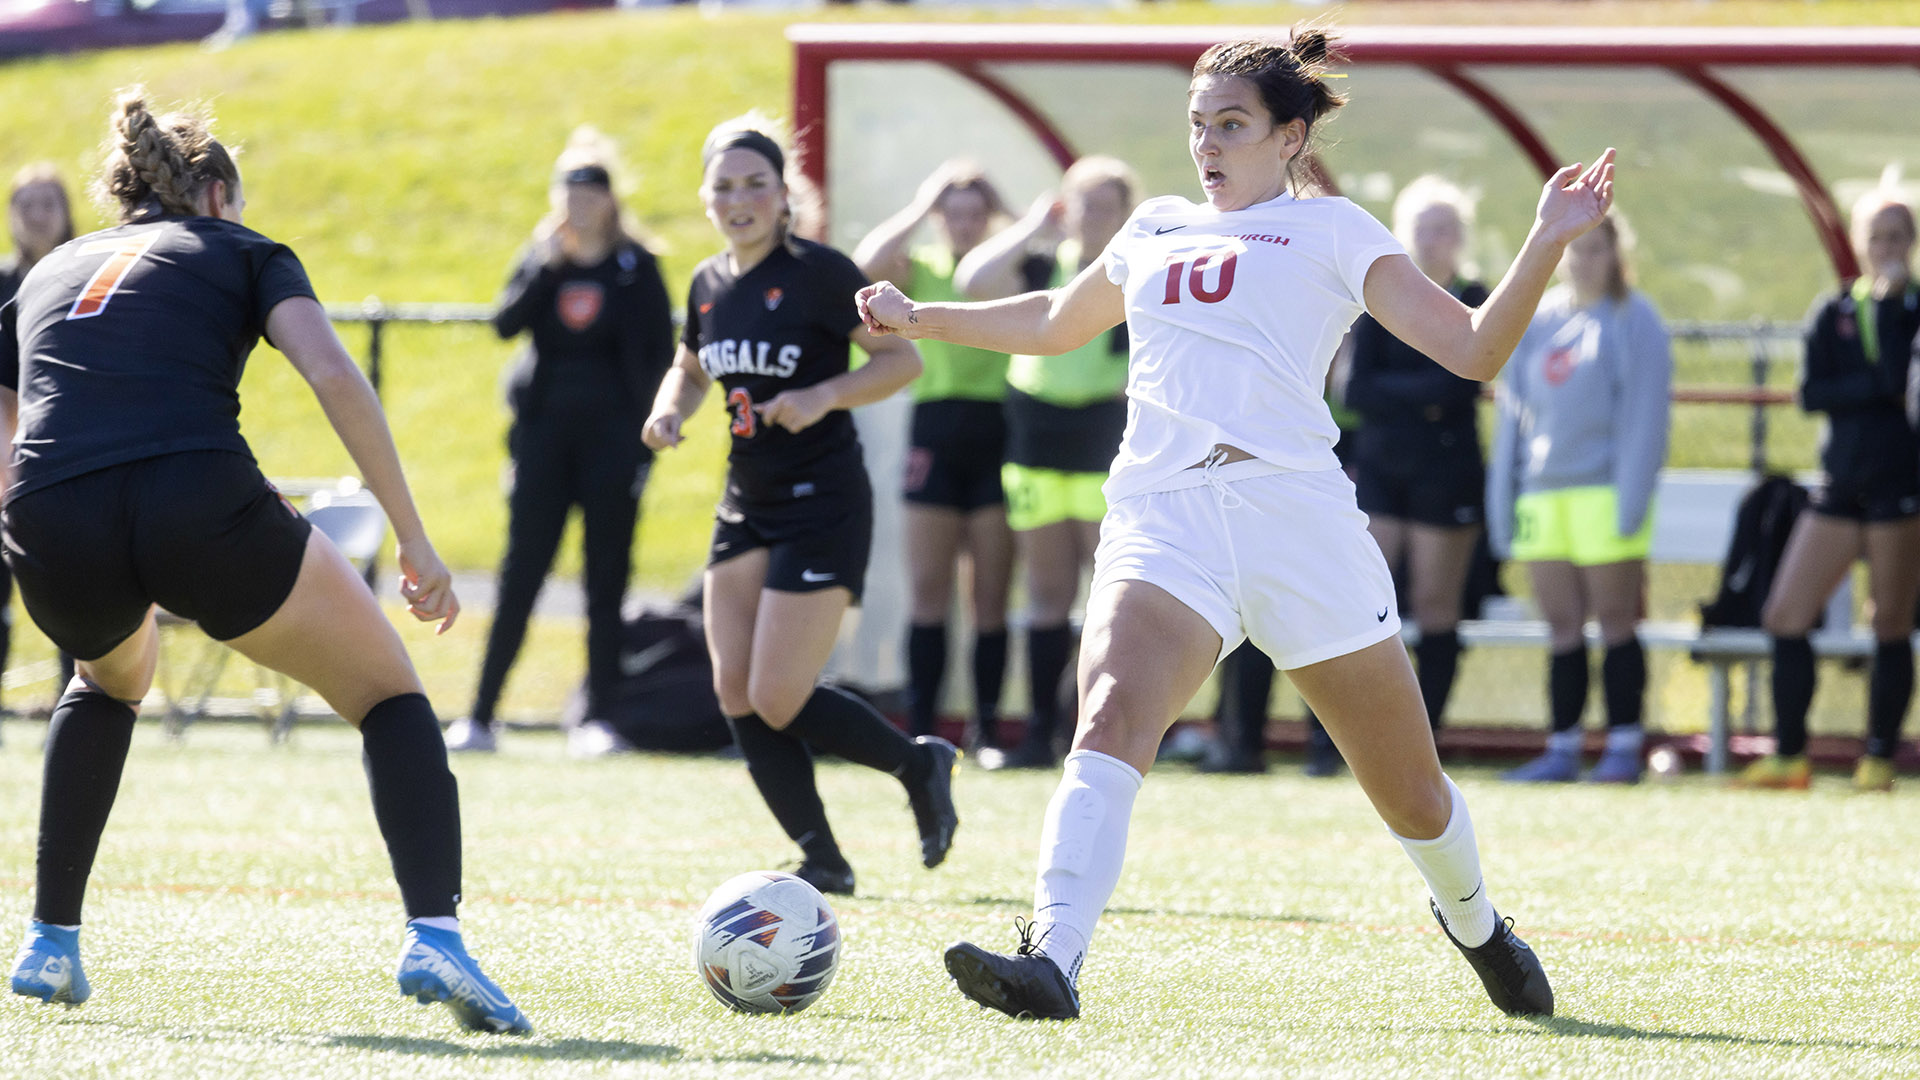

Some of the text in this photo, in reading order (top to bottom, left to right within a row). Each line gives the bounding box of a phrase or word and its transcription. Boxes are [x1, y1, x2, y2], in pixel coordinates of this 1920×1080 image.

[66, 229, 162, 320] 7
[1162, 250, 1237, 304] 10
[728, 387, 756, 438] 3
